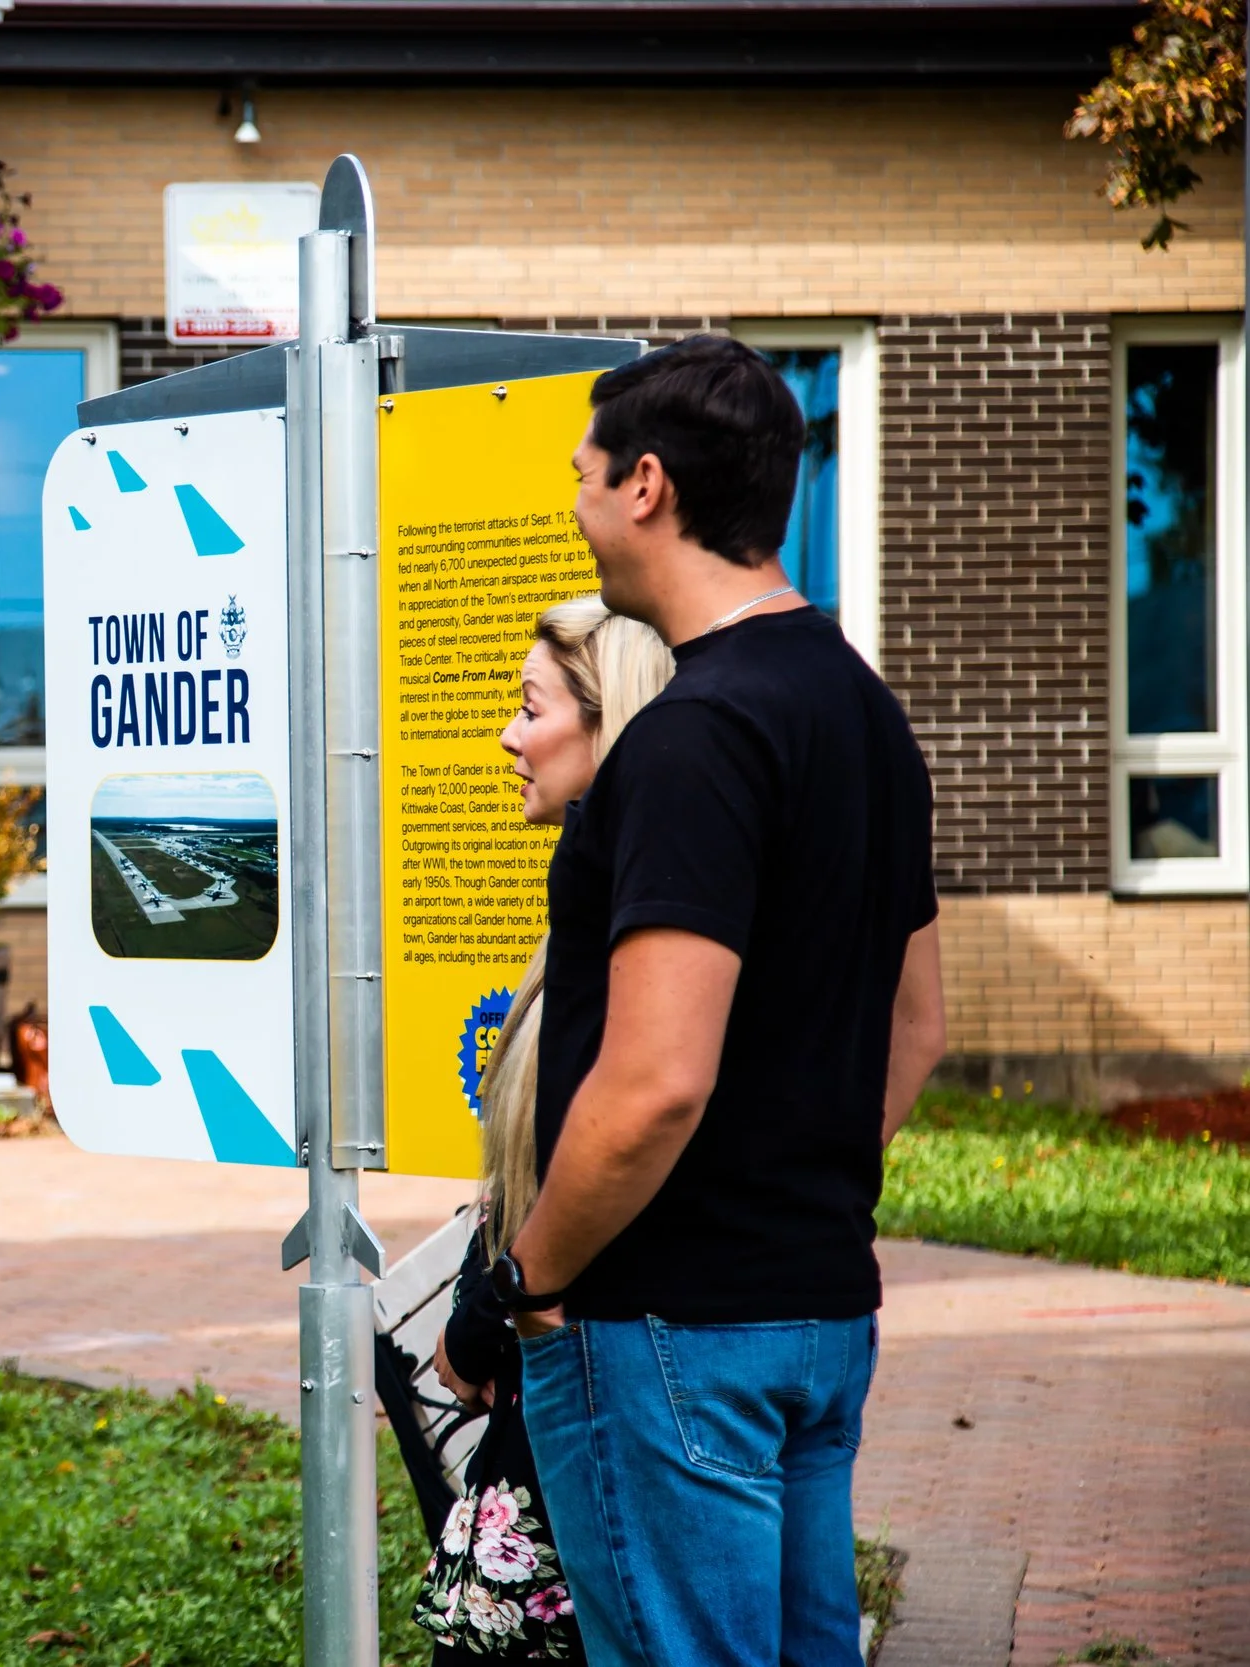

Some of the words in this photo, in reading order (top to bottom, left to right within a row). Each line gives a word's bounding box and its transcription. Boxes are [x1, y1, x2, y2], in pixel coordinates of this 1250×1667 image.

[398, 524, 437, 537] Following
[438, 522, 453, 534] the
[453, 520, 486, 532] terrorist
[487, 517, 519, 530] attacks
[520, 514, 530, 527] of
[531, 513, 554, 527] Sept.
[556, 512, 567, 524] 11,
[398, 544, 414, 556] and
[416, 540, 465, 555] surrounding
[467, 536, 521, 550] communities
[523, 530, 570, 545] welcomed,
[398, 562, 412, 574] fed
[413, 560, 439, 575] nearly
[440, 557, 466, 572] 6,700
[467, 554, 518, 569] unexpected
[518, 553, 549, 568] guests
[549, 551, 562, 562] for
[563, 552, 576, 563] up
[577, 550, 586, 560] to
[399, 581, 421, 592] when
[423, 579, 432, 591] all
[434, 578, 458, 590] North
[460, 577, 500, 588] American
[501, 574, 538, 586] airspace
[540, 572, 557, 582] was
[559, 567, 593, 581] ordered
[399, 599, 407, 611] In
[408, 598, 459, 612] appreciation
[460, 595, 469, 607] of
[470, 595, 485, 606] the
[517, 589, 574, 603] extraordinary
[399, 618, 415, 630] and
[416, 616, 461, 632] generosity,
[463, 613, 495, 626] Gander
[497, 614, 514, 623] was
[516, 611, 534, 622] later
[89, 613, 165, 665] TOWN
[177, 610, 209, 661] OF
[399, 638, 426, 650] pieces
[428, 634, 436, 647] of
[438, 633, 458, 646] steel
[460, 631, 501, 645] recovered
[503, 630, 523, 642] from
[399, 655, 423, 666] Trade
[425, 653, 454, 665] Center.
[456, 651, 473, 663] The
[474, 650, 508, 664] critically
[510, 649, 530, 661] accl
[400, 673, 431, 685] musical
[433, 671, 460, 684] Come
[462, 670, 487, 682] From
[488, 668, 514, 683] Away
[400, 691, 430, 703] interest
[432, 690, 439, 702] in
[440, 690, 455, 702] the
[456, 688, 505, 702] community,
[91, 668, 250, 748] GANDER
[400, 711, 409, 722] all
[411, 712, 429, 722] over
[430, 710, 444, 721] the
[445, 708, 469, 723] globe
[471, 709, 479, 719] to
[481, 709, 496, 719] see
[498, 706, 512, 718] the
[401, 730, 409, 741] to
[411, 727, 460, 740] international
[462, 727, 494, 738] acclaim
[401, 765, 417, 777] The
[419, 765, 441, 777] Town
[443, 764, 451, 776] of
[453, 764, 484, 776] Gander
[486, 763, 492, 775] is
[495, 765, 500, 775] a
[402, 784, 410, 796] of
[411, 784, 436, 798] nearly
[438, 782, 468, 796] 12,000
[469, 782, 500, 796] people.
[502, 781, 519, 793] The
[402, 802, 438, 814] Kittiwake
[440, 801, 466, 814] Coast,
[469, 801, 500, 813] Gander
[502, 801, 509, 812] is
[511, 803, 516, 812] a
[402, 822, 450, 836] government
[453, 820, 489, 833] services,
[491, 820, 507, 832] and
[402, 839, 450, 854] Outgrowing
[452, 838, 461, 851] its
[463, 839, 493, 853] original
[495, 838, 528, 850] location
[530, 840, 541, 850] on
[403, 858, 421, 870] after
[449, 858, 464, 869] the
[465, 859, 486, 869] town
[487, 857, 517, 869] moved
[517, 858, 527, 869] to
[528, 857, 539, 869] its
[402, 877, 422, 891] early
[424, 876, 452, 888] 1950s.
[454, 876, 487, 891] Though
[488, 875, 520, 888] Gander
[403, 897, 413, 907] an
[415, 895, 441, 908] airport
[443, 895, 465, 908] town,
[468, 897, 473, 907] a
[475, 894, 495, 907] wide
[497, 894, 524, 909] variety
[526, 895, 534, 907] of
[403, 914, 457, 928] organizations
[459, 914, 473, 925] call
[474, 913, 506, 926] Gander
[508, 914, 533, 926] home.
[536, 913, 543, 925] A
[404, 931, 426, 946] town,
[428, 931, 458, 944] Gander
[460, 932, 475, 944] has
[477, 933, 516, 945] abundant
[404, 950, 412, 962] all
[415, 952, 437, 965] ages,
[438, 951, 475, 966] including
[477, 951, 491, 963] the
[493, 952, 509, 963] arts
[510, 952, 527, 964] and
